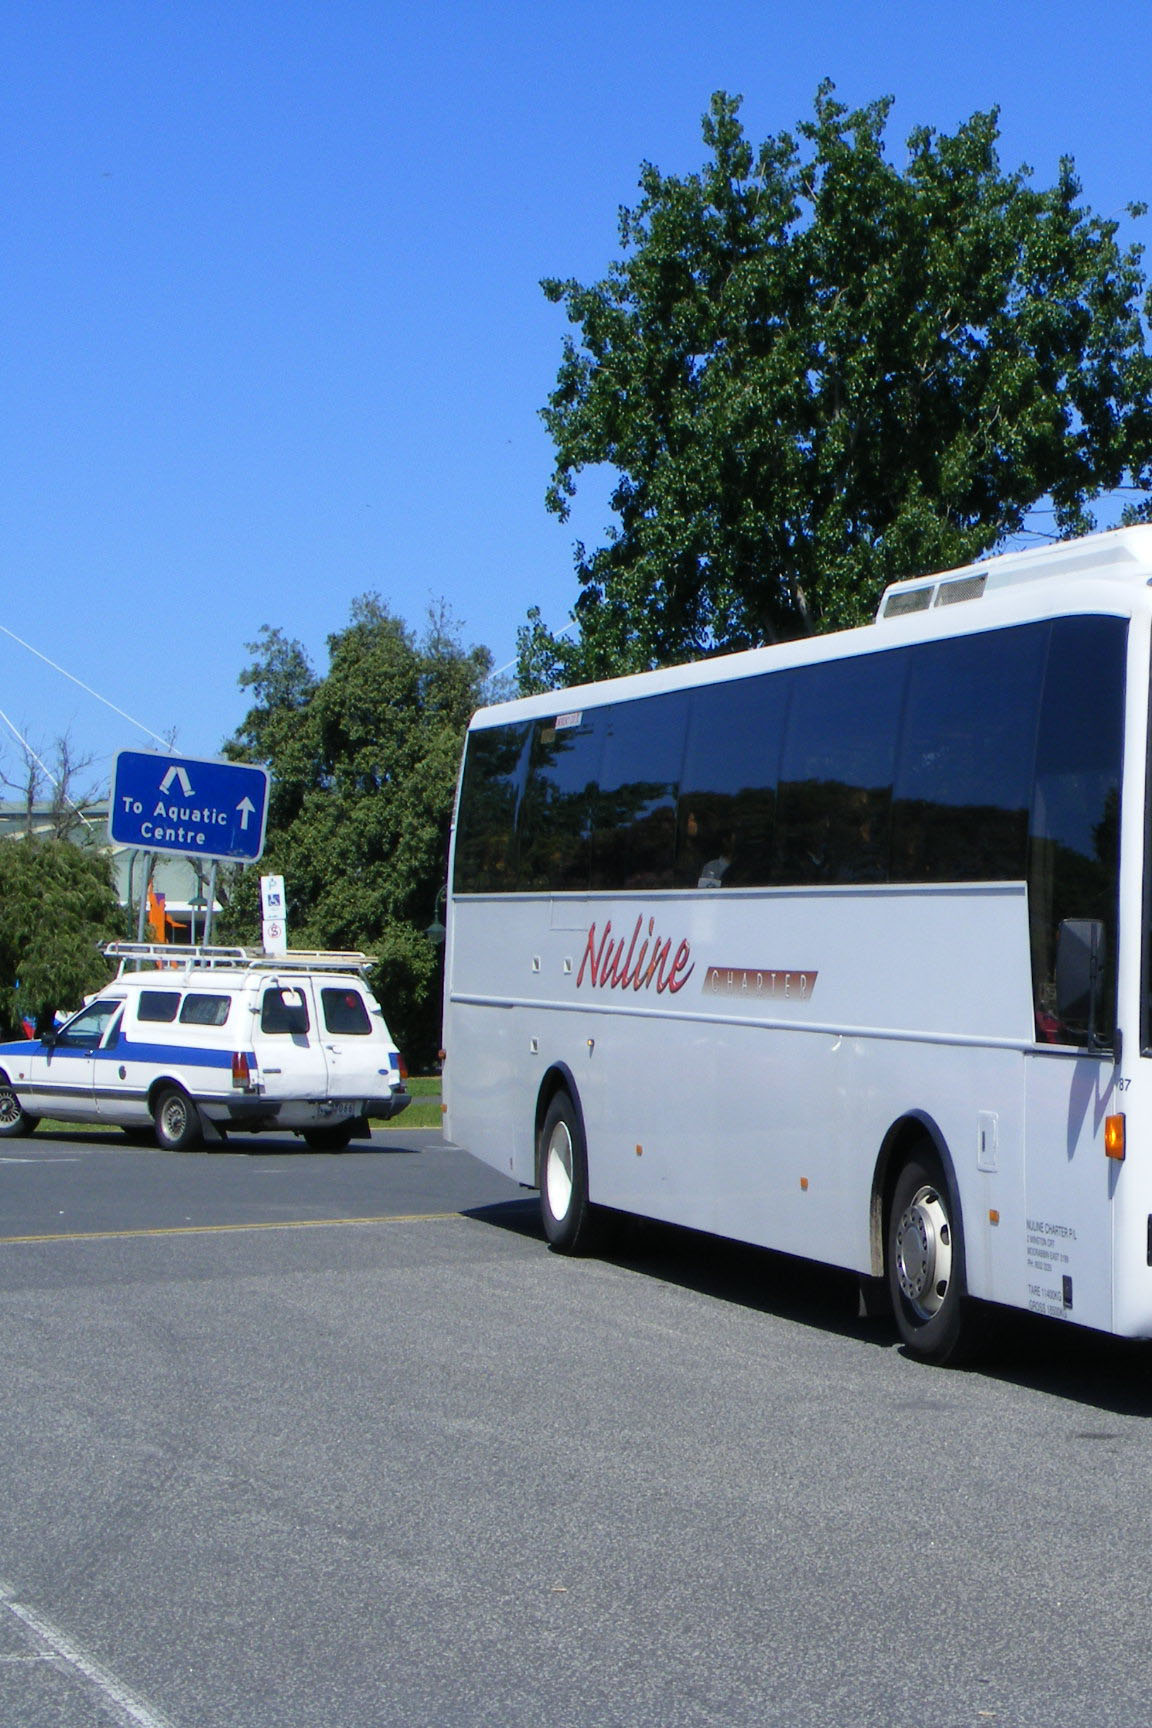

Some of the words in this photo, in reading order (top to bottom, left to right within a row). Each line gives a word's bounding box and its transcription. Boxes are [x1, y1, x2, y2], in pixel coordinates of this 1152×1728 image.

[122, 797, 143, 814] To
[153, 801, 228, 826] Aquatic
[141, 822, 206, 845] Centre
[576, 912, 696, 994] Nuline
[710, 969, 808, 999] CHARTER
[1026, 1219, 1044, 1234] NULINE
[1045, 1222, 1068, 1238] CHARTER
[1028, 1284, 1041, 1298] TARE
